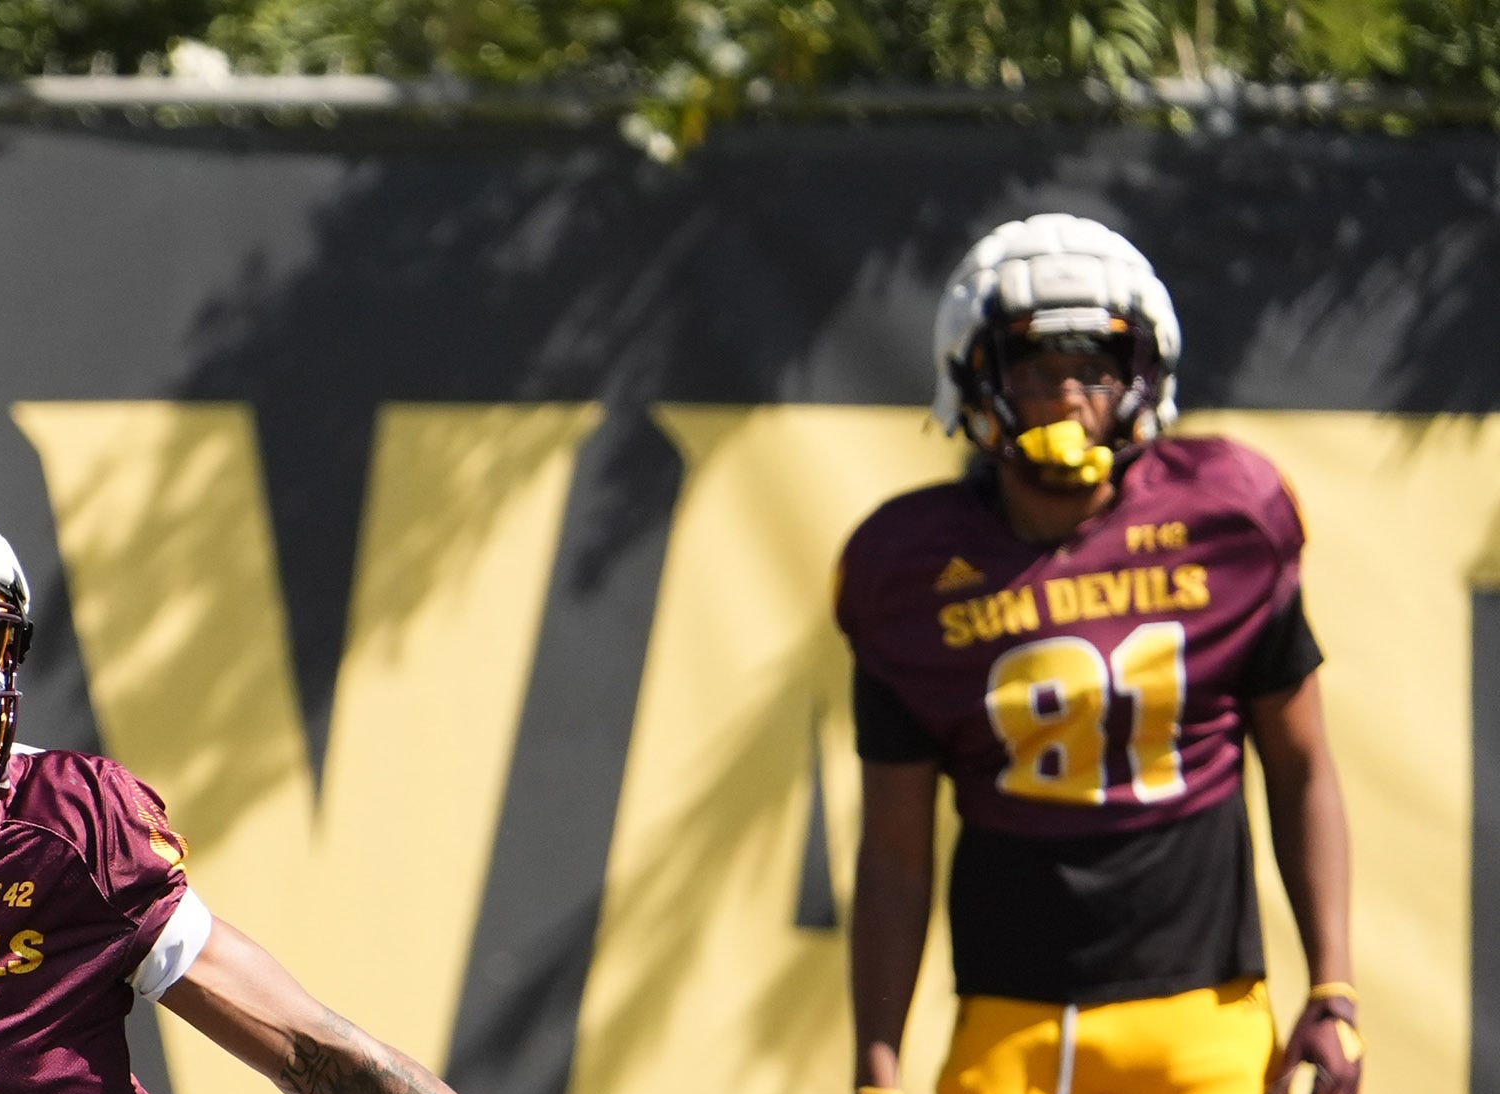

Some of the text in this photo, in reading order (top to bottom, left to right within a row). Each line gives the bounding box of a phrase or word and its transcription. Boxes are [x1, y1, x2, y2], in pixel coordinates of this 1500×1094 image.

[938, 564, 1211, 647] SUN DEVILS
[985, 621, 1186, 805] 81
[2, 881, 36, 908] 42
